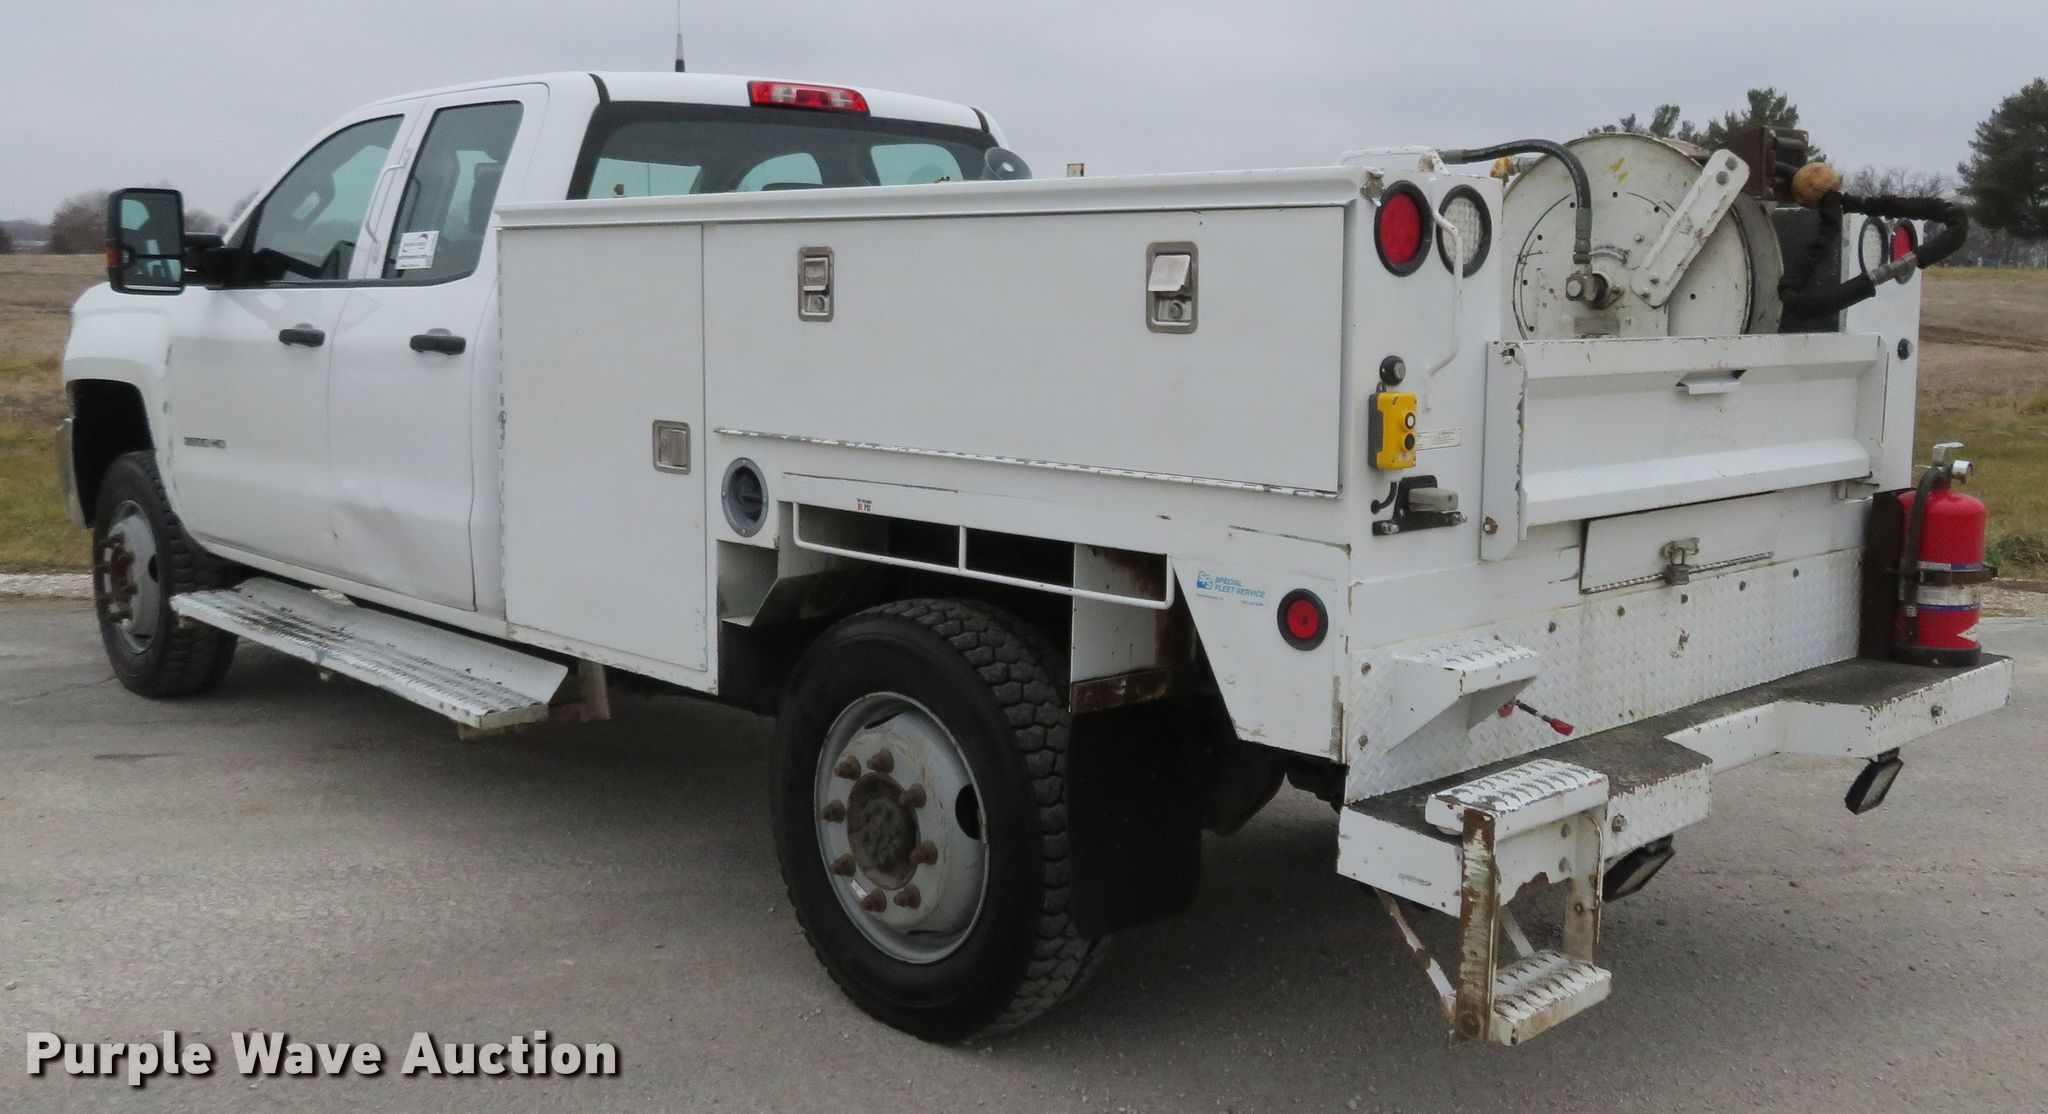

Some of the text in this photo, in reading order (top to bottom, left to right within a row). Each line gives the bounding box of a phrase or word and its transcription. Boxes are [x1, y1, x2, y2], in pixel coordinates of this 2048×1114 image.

[1214, 576, 1242, 587] SPECIAL
[1214, 585, 1266, 598] FLEET SERVICE
